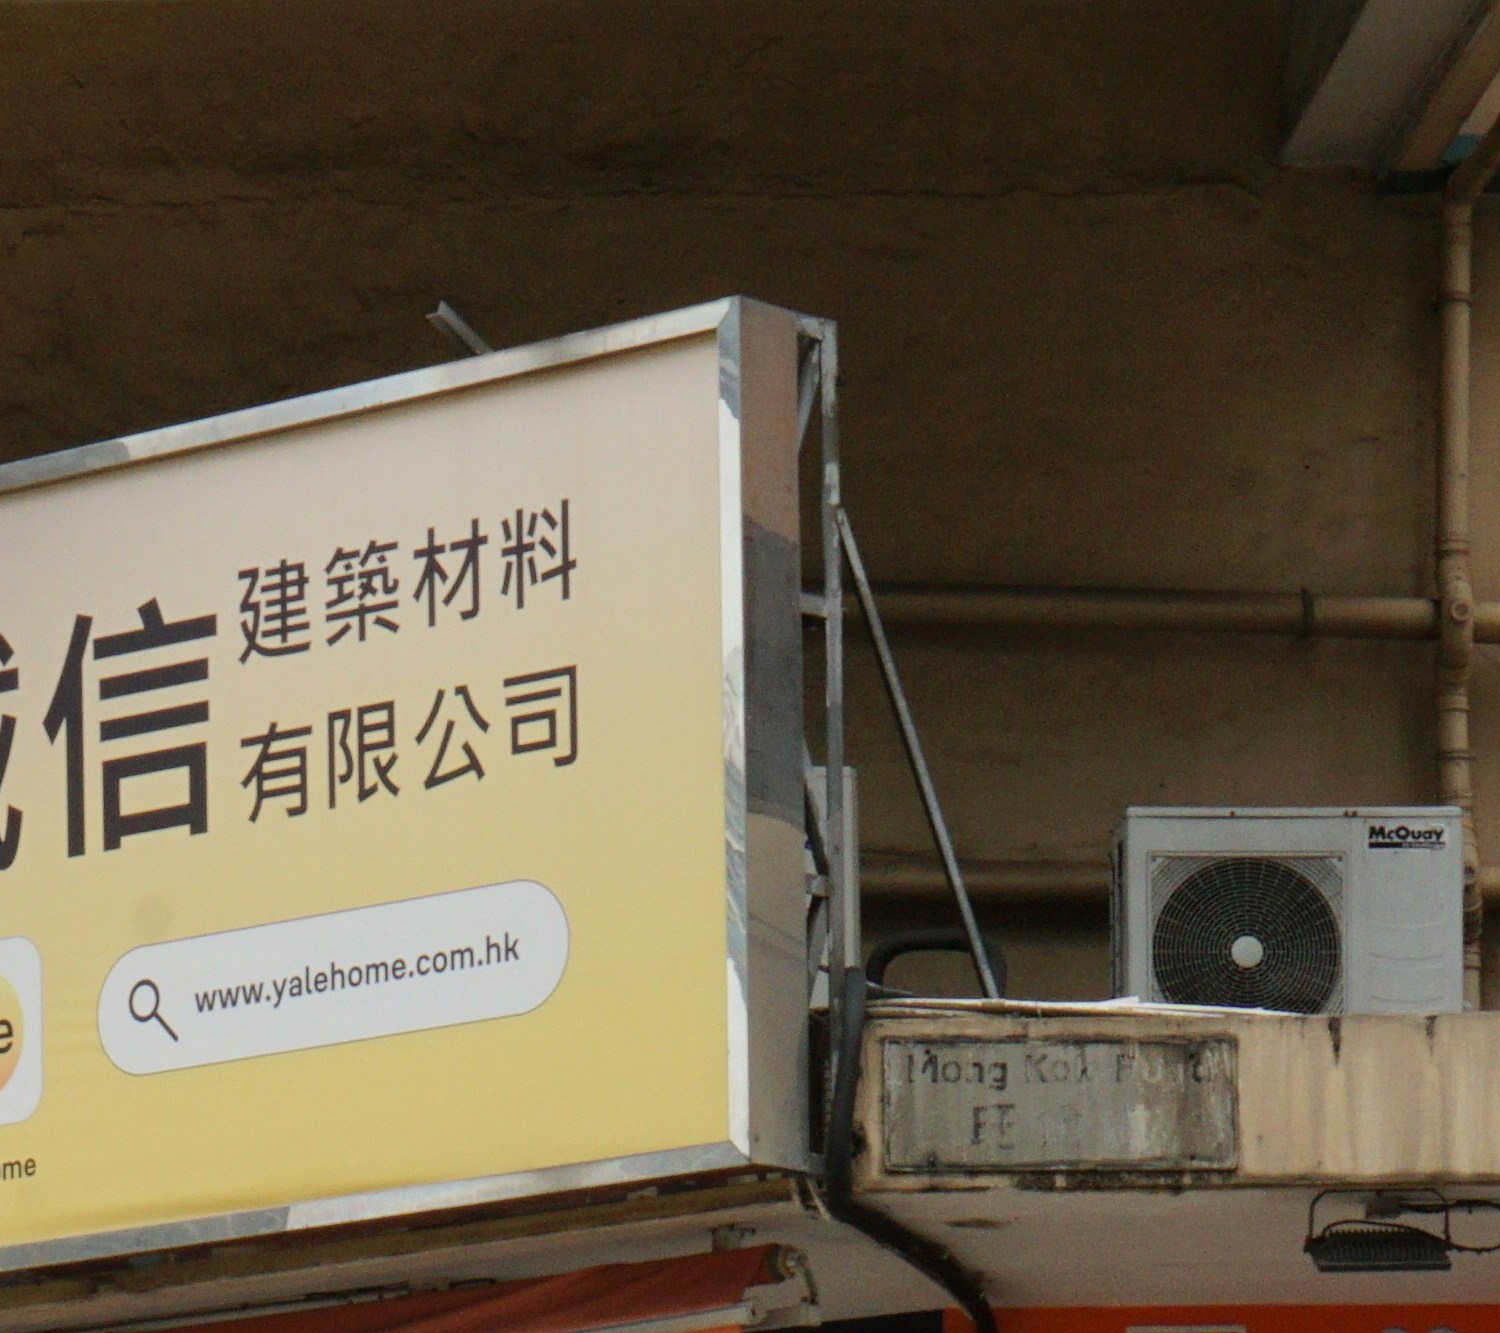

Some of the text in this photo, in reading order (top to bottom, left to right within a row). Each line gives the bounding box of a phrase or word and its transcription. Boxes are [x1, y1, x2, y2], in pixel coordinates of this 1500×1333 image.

[237, 498, 578, 665] 建築材料
[239, 665, 579, 823] 有限公司
[1368, 825, 1444, 841] McQuay
[195, 932, 521, 1014] www.yalehome.com.hk
